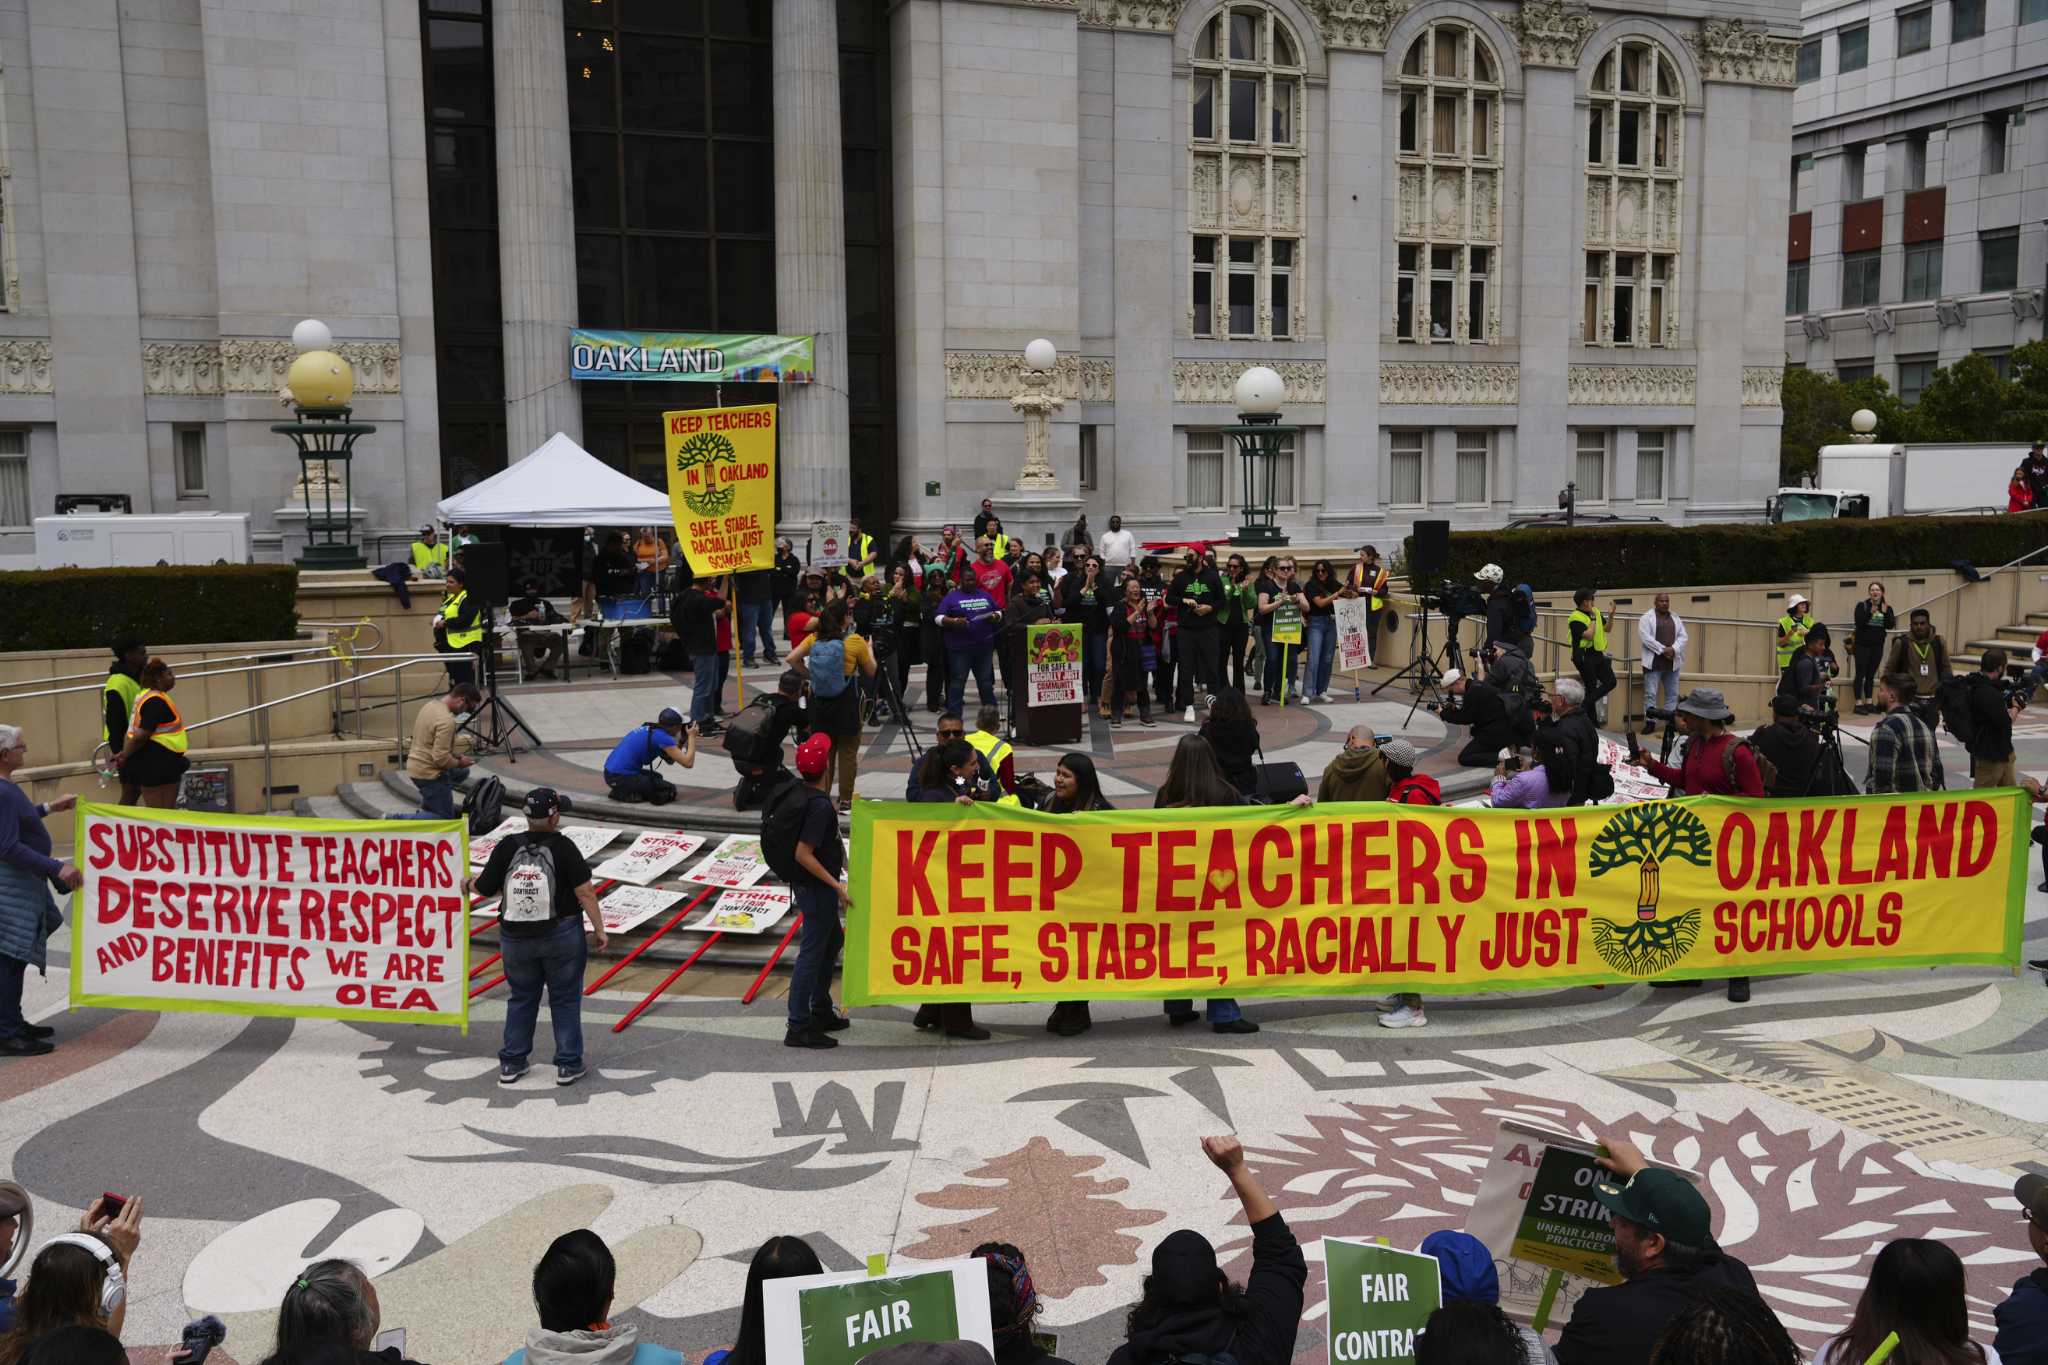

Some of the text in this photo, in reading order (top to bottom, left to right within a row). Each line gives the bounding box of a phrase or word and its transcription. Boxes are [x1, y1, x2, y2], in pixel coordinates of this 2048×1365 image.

[572, 344, 725, 373] OAKLAND
[671, 411, 772, 435] KEEP TEACHERS
[687, 463, 769, 486] IN OAKLAND
[689, 514, 760, 538] SAFE, STABLE,
[691, 531, 764, 554] RACIALLY JUST
[708, 550, 752, 570] SCHOOLS
[1040, 690, 1072, 701] SCHOOLS
[88, 823, 454, 889] SUBSTITUTE TEACHERS
[641, 837, 694, 852] STRIKE
[896, 800, 1998, 917] KEEP TEACHERS IN OAKLAND
[719, 905, 771, 914] CONTRACT
[723, 893, 791, 904] STRIKE
[97, 876, 462, 949] DESERVE RESPECT
[890, 891, 1905, 989] SAFE, STABLE, RACIALLY JUST SCHOOLS
[97, 932, 444, 991] AND BENEFITS WE ARE
[335, 984, 438, 1012] OEA
[1574, 1167, 1613, 1187] ON
[1539, 1194, 1613, 1222] STRIK
[1536, 1222, 1580, 1238] UNFAIR
[1545, 1234, 1607, 1252] PRACTICES
[1361, 1272, 1410, 1304] FAIR
[845, 1299, 913, 1348] FAIR
[1334, 1328, 1426, 1361] CONTRA
